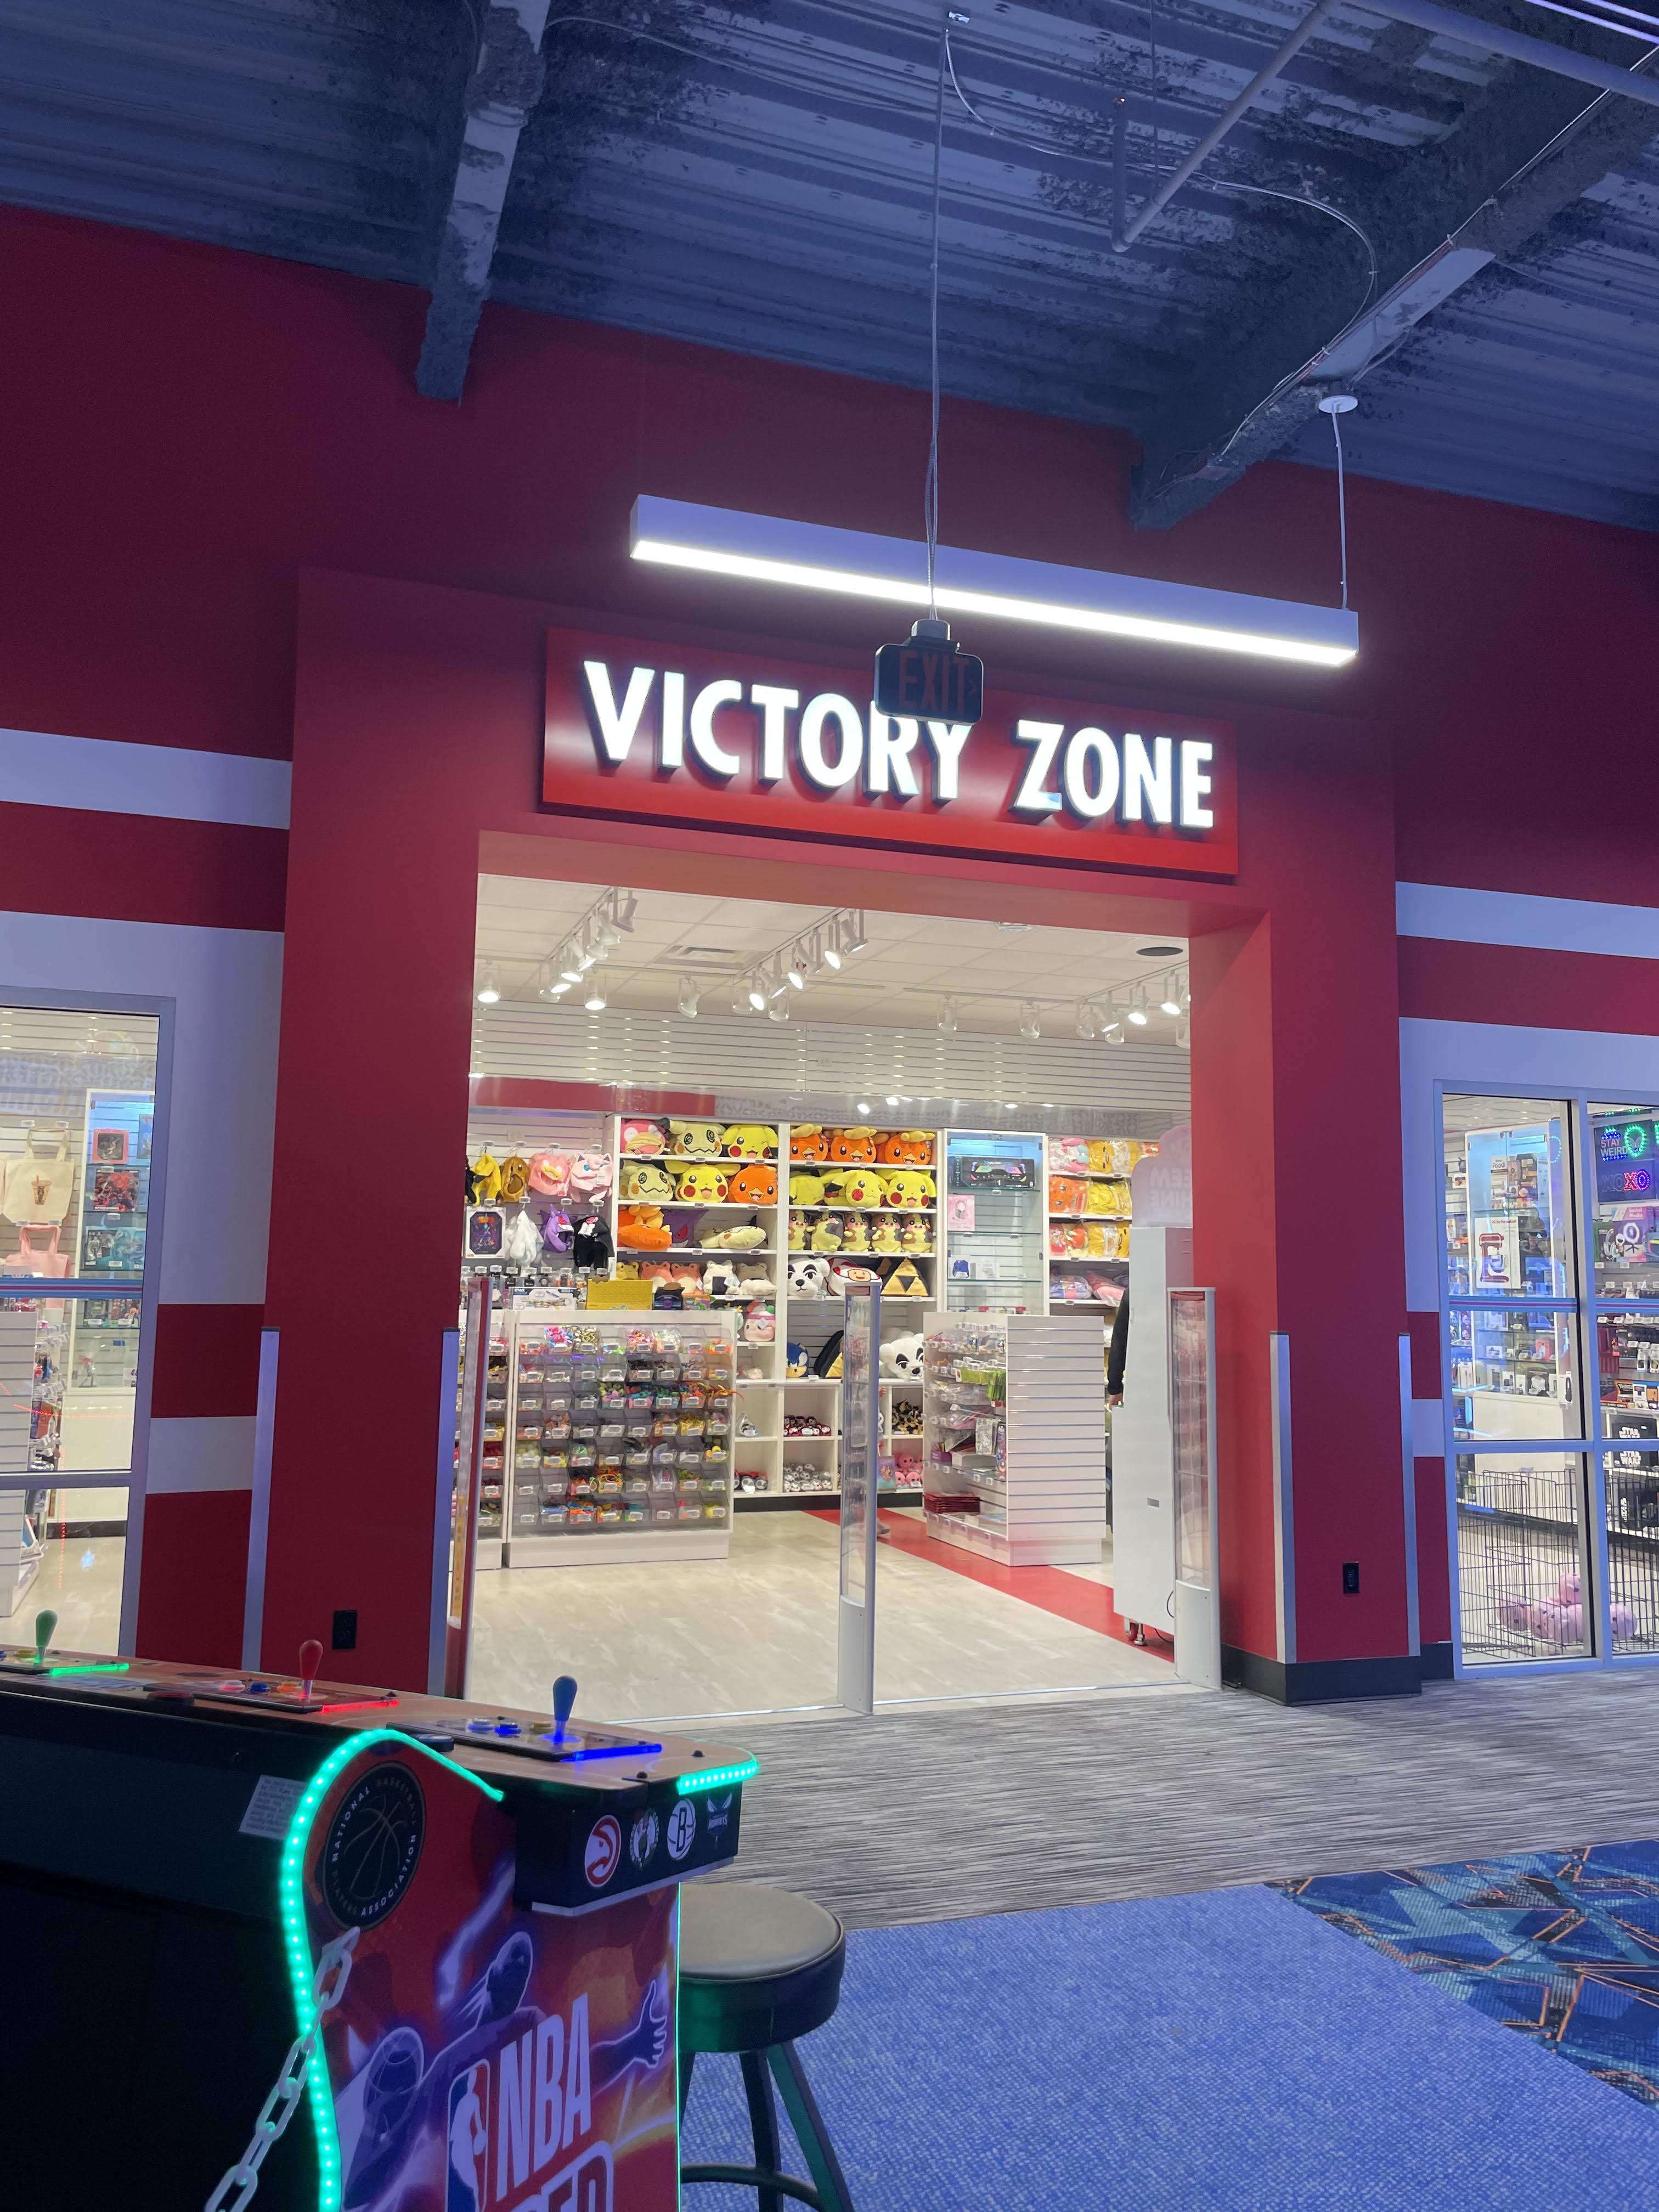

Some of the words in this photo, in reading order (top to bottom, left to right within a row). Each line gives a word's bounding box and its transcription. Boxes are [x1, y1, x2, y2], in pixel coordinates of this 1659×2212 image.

[899, 649, 970, 714] EXIT
[583, 660, 974, 802] VICTORY
[1008, 718, 1215, 830] ZONE
[1601, 1138, 1620, 1148] STAY
[1601, 1146, 1628, 1156] WEIRD
[1619, 1426, 1640, 1435] STAR
[1620, 1455, 1641, 1465] WARS
[332, 1786, 370, 1862] NATIONAL
[361, 1835, 417, 1916] ASSOCIATION
[496, 1992, 591, 2202] NBA
